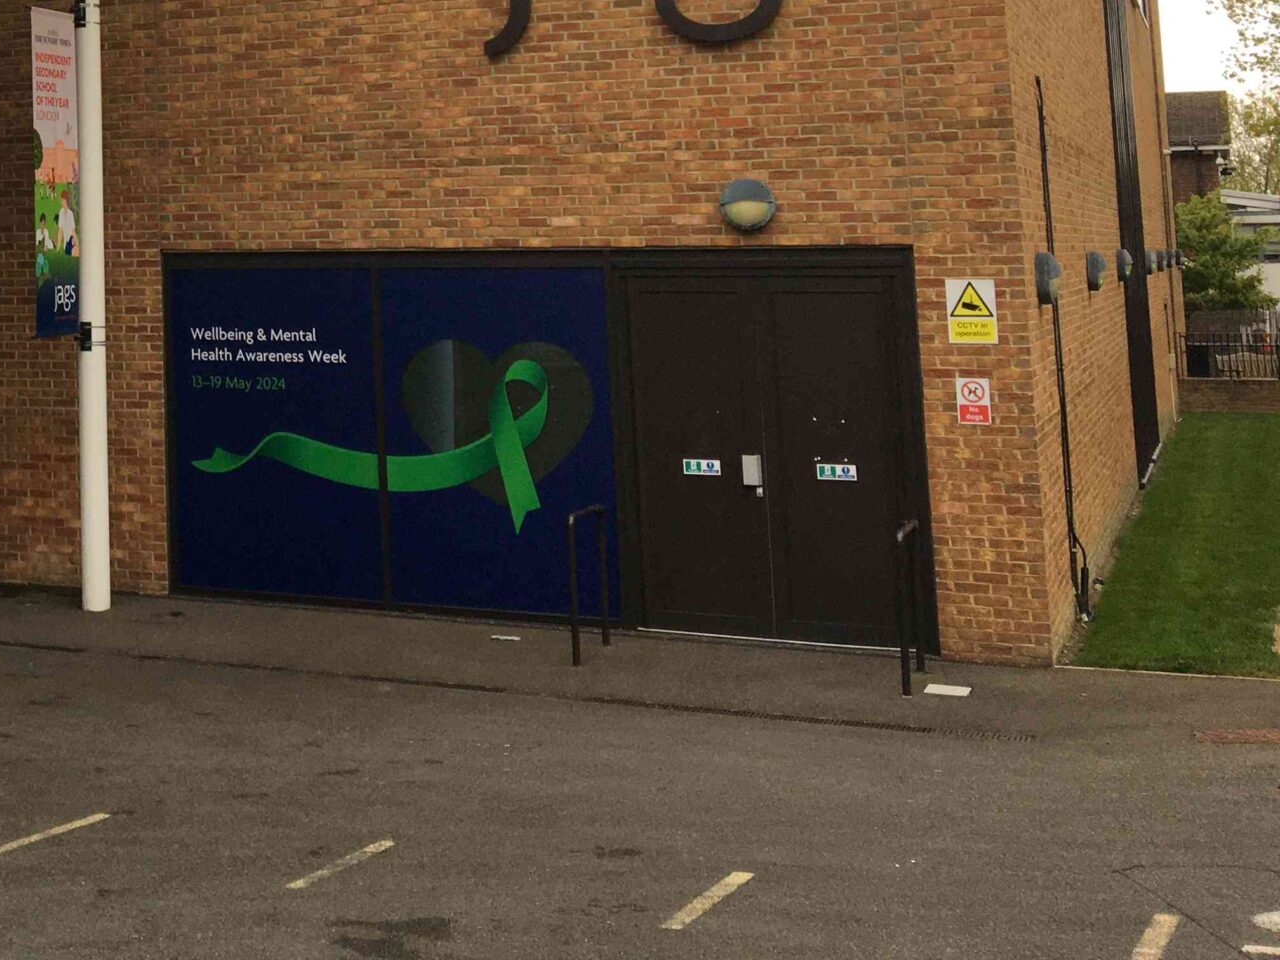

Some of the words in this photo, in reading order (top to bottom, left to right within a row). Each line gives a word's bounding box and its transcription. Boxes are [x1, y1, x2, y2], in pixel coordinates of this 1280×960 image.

[53, 282, 76, 313] jags
[191, 327, 254, 344] Wellbeing
[257, 328, 267, 341] &
[270, 328, 317, 342] Mental
[954, 330, 991, 338] operation
[191, 347, 232, 361] Health
[236, 349, 304, 363] Awareness
[308, 349, 347, 364] Week
[225, 376, 253, 392] May
[256, 376, 286, 390] 2024
[965, 413, 984, 421] dogs
